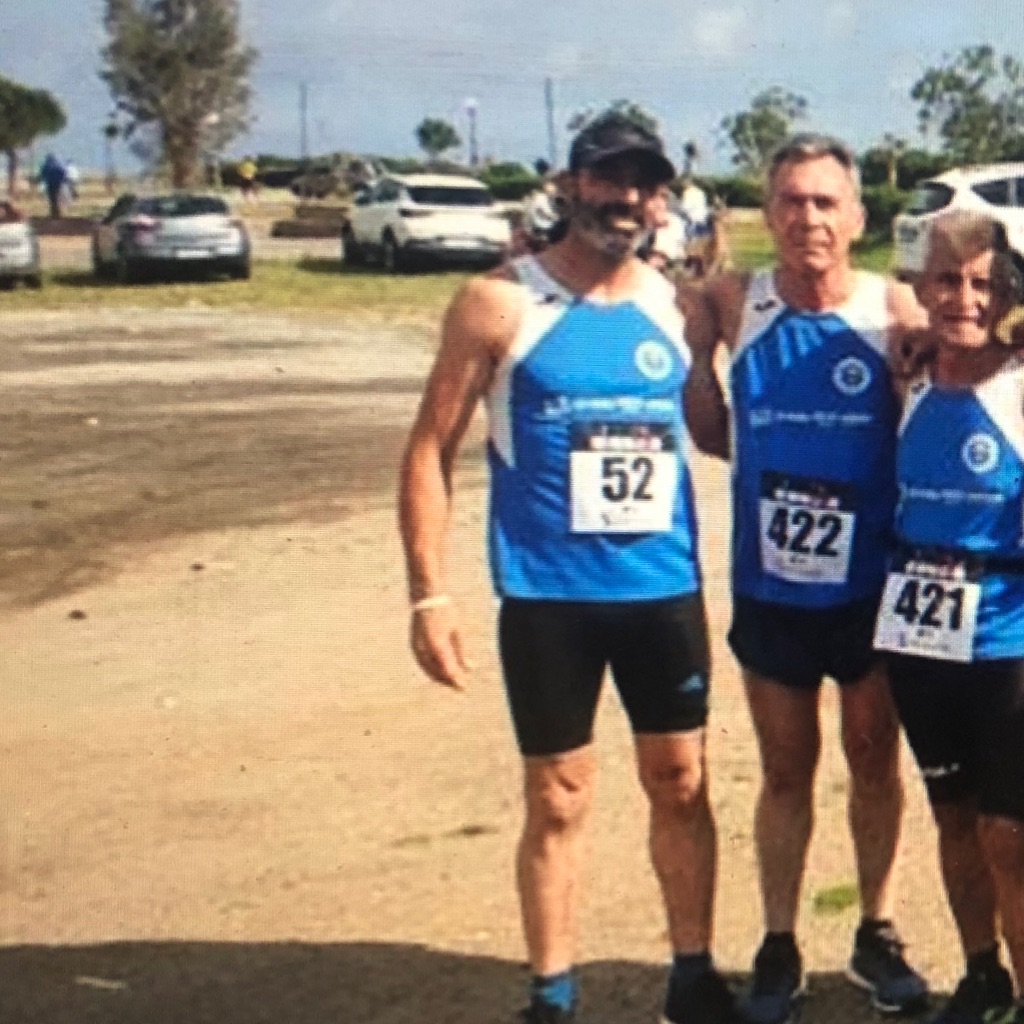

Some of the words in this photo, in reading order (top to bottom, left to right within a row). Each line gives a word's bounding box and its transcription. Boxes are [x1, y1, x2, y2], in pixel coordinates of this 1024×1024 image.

[601, 456, 654, 503] 52
[767, 507, 842, 556] 422
[893, 579, 965, 631] 421
